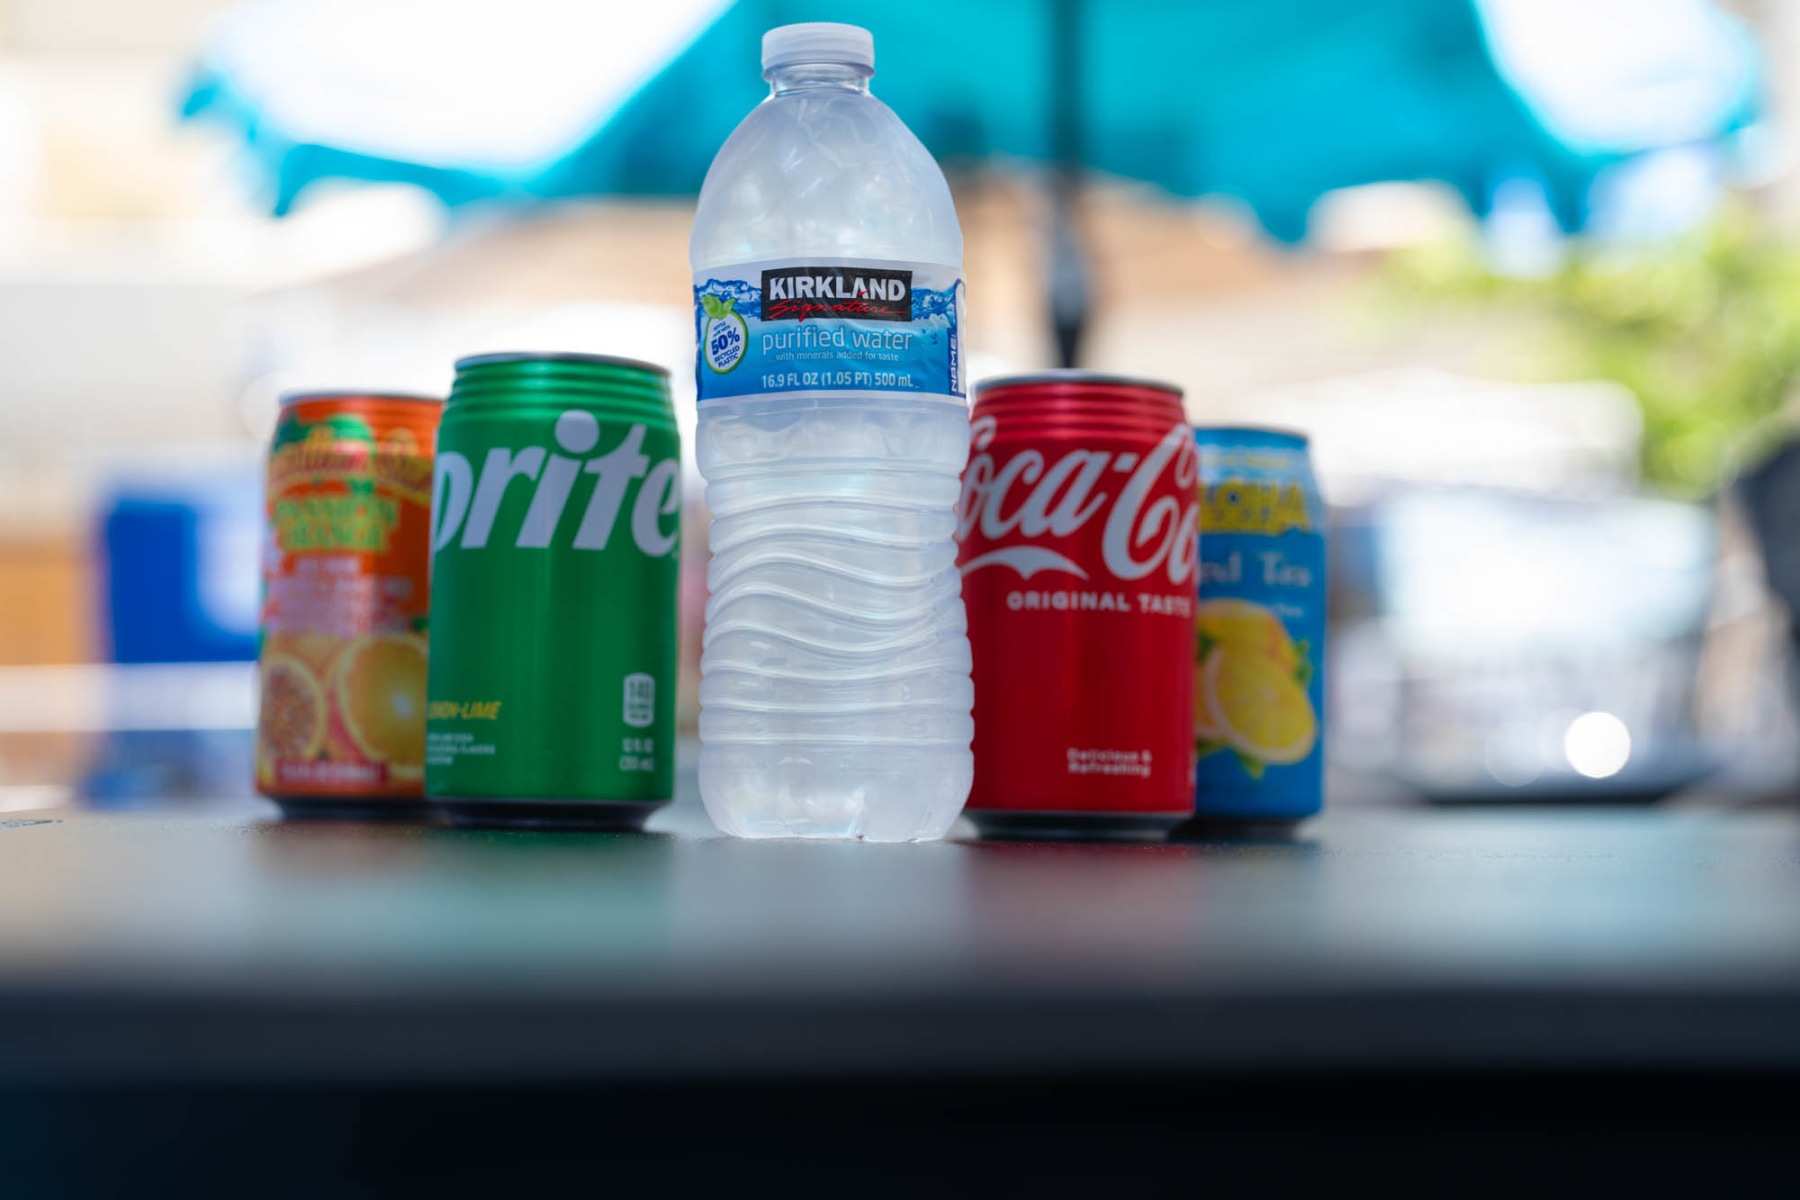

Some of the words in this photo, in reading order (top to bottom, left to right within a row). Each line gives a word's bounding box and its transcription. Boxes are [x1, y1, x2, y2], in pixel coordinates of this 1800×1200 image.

[769, 276, 906, 301] KIRKLAND
[768, 299, 906, 322] Signature
[711, 327, 740, 355] 50%
[762, 326, 845, 356] purified
[852, 330, 913, 350] water
[714, 345, 740, 362] RECYCLED
[718, 353, 738, 368] PLASTIC
[775, 351, 795, 361] with
[796, 351, 834, 361] minerals
[836, 350, 863, 360] added
[865, 351, 877, 361] for
[878, 352, 900, 362] taste
[761, 374, 785, 389] 16.9
[787, 373, 800, 386] FL
[802, 371, 819, 386] OZ
[821, 371, 852, 386] (1.05
[854, 371, 873, 387] PT)
[875, 372, 896, 387] 500
[898, 375, 914, 388] mL
[1006, 591, 1131, 612] ORIGINAL
